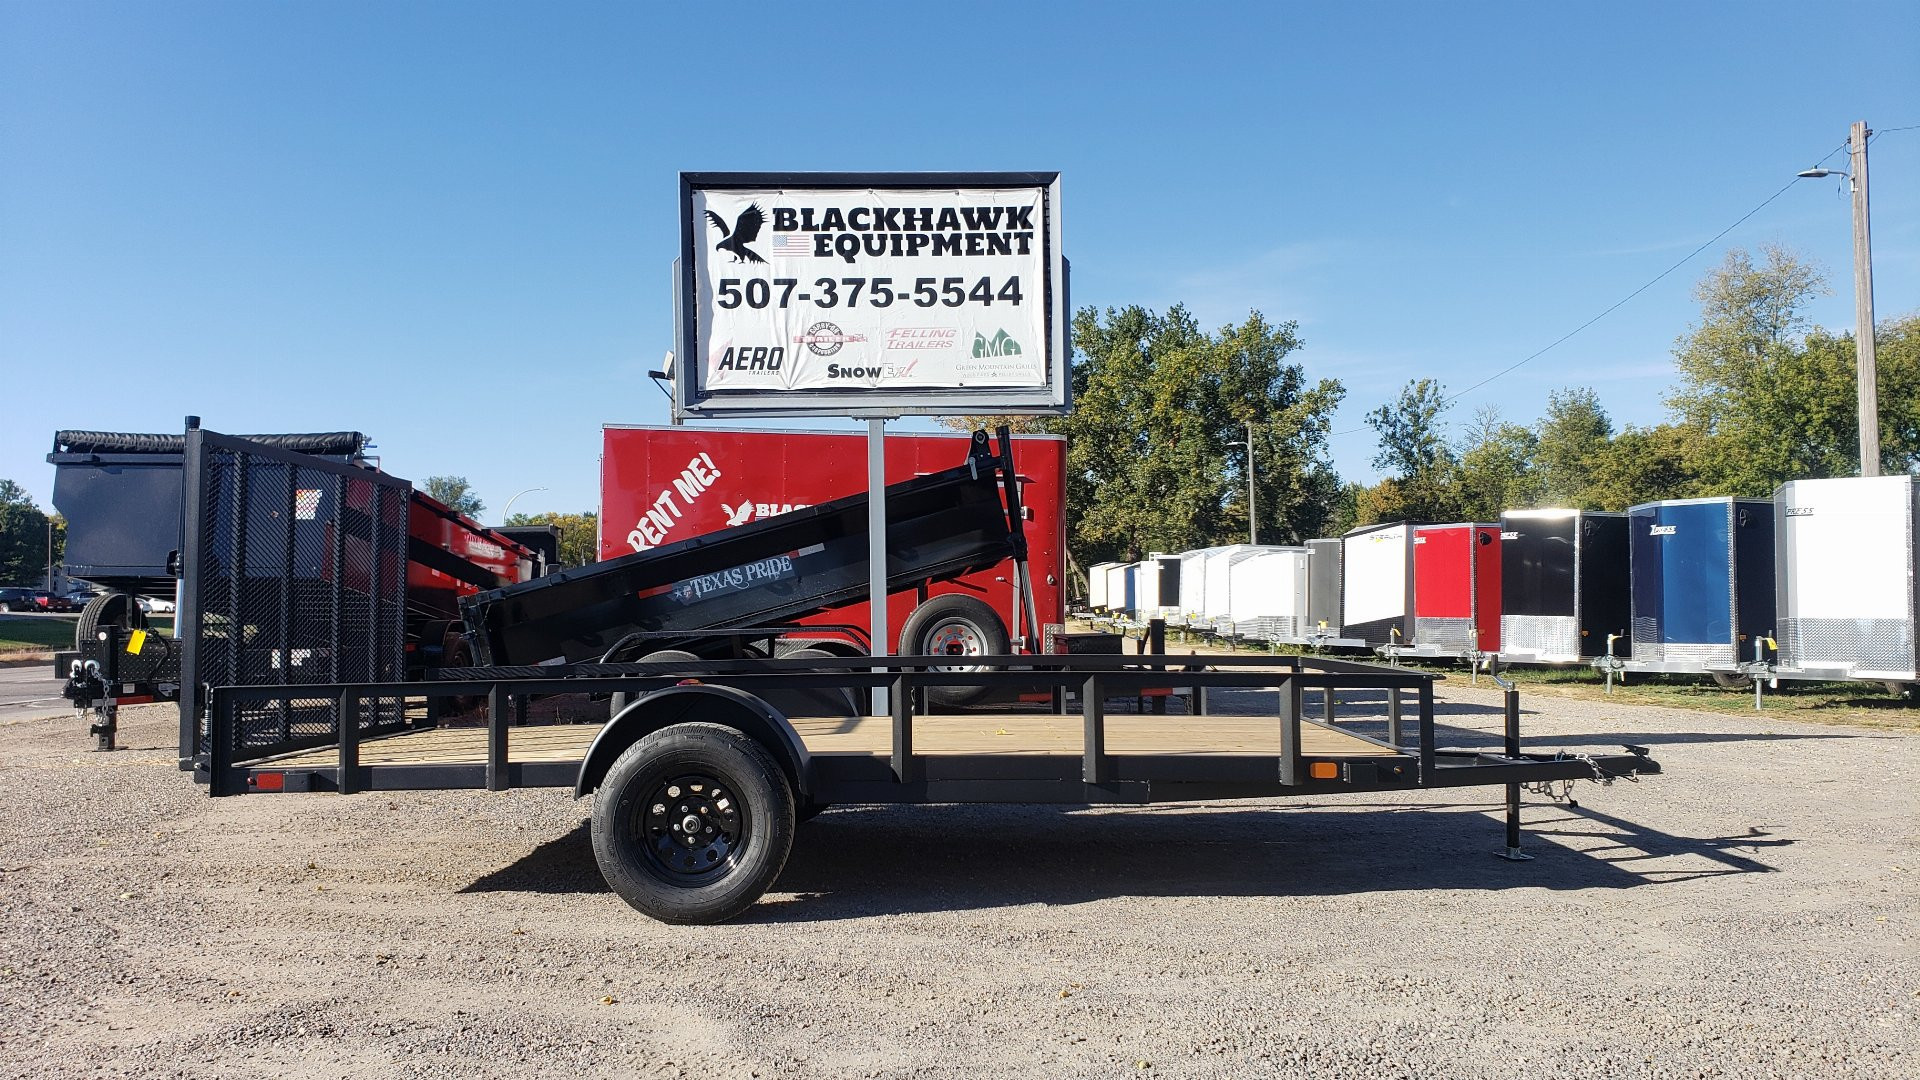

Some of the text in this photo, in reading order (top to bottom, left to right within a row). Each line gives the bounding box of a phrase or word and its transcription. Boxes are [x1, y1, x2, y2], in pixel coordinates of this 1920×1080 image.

[772, 205, 1034, 232] BLACKHAWK
[814, 232, 1033, 263] EQUIPMENT
[718, 275, 1023, 309] 507-375-5544
[886, 327, 956, 339] FELLING
[887, 339, 954, 350] TRAILERS
[718, 347, 784, 371] AERO
[971, 336, 1016, 358] GMG
[979, 363, 1015, 371] MOUNTAIN
[627, 452, 721, 552] RENT ME!
[690, 556, 792, 598] TEXAS PRIDE
